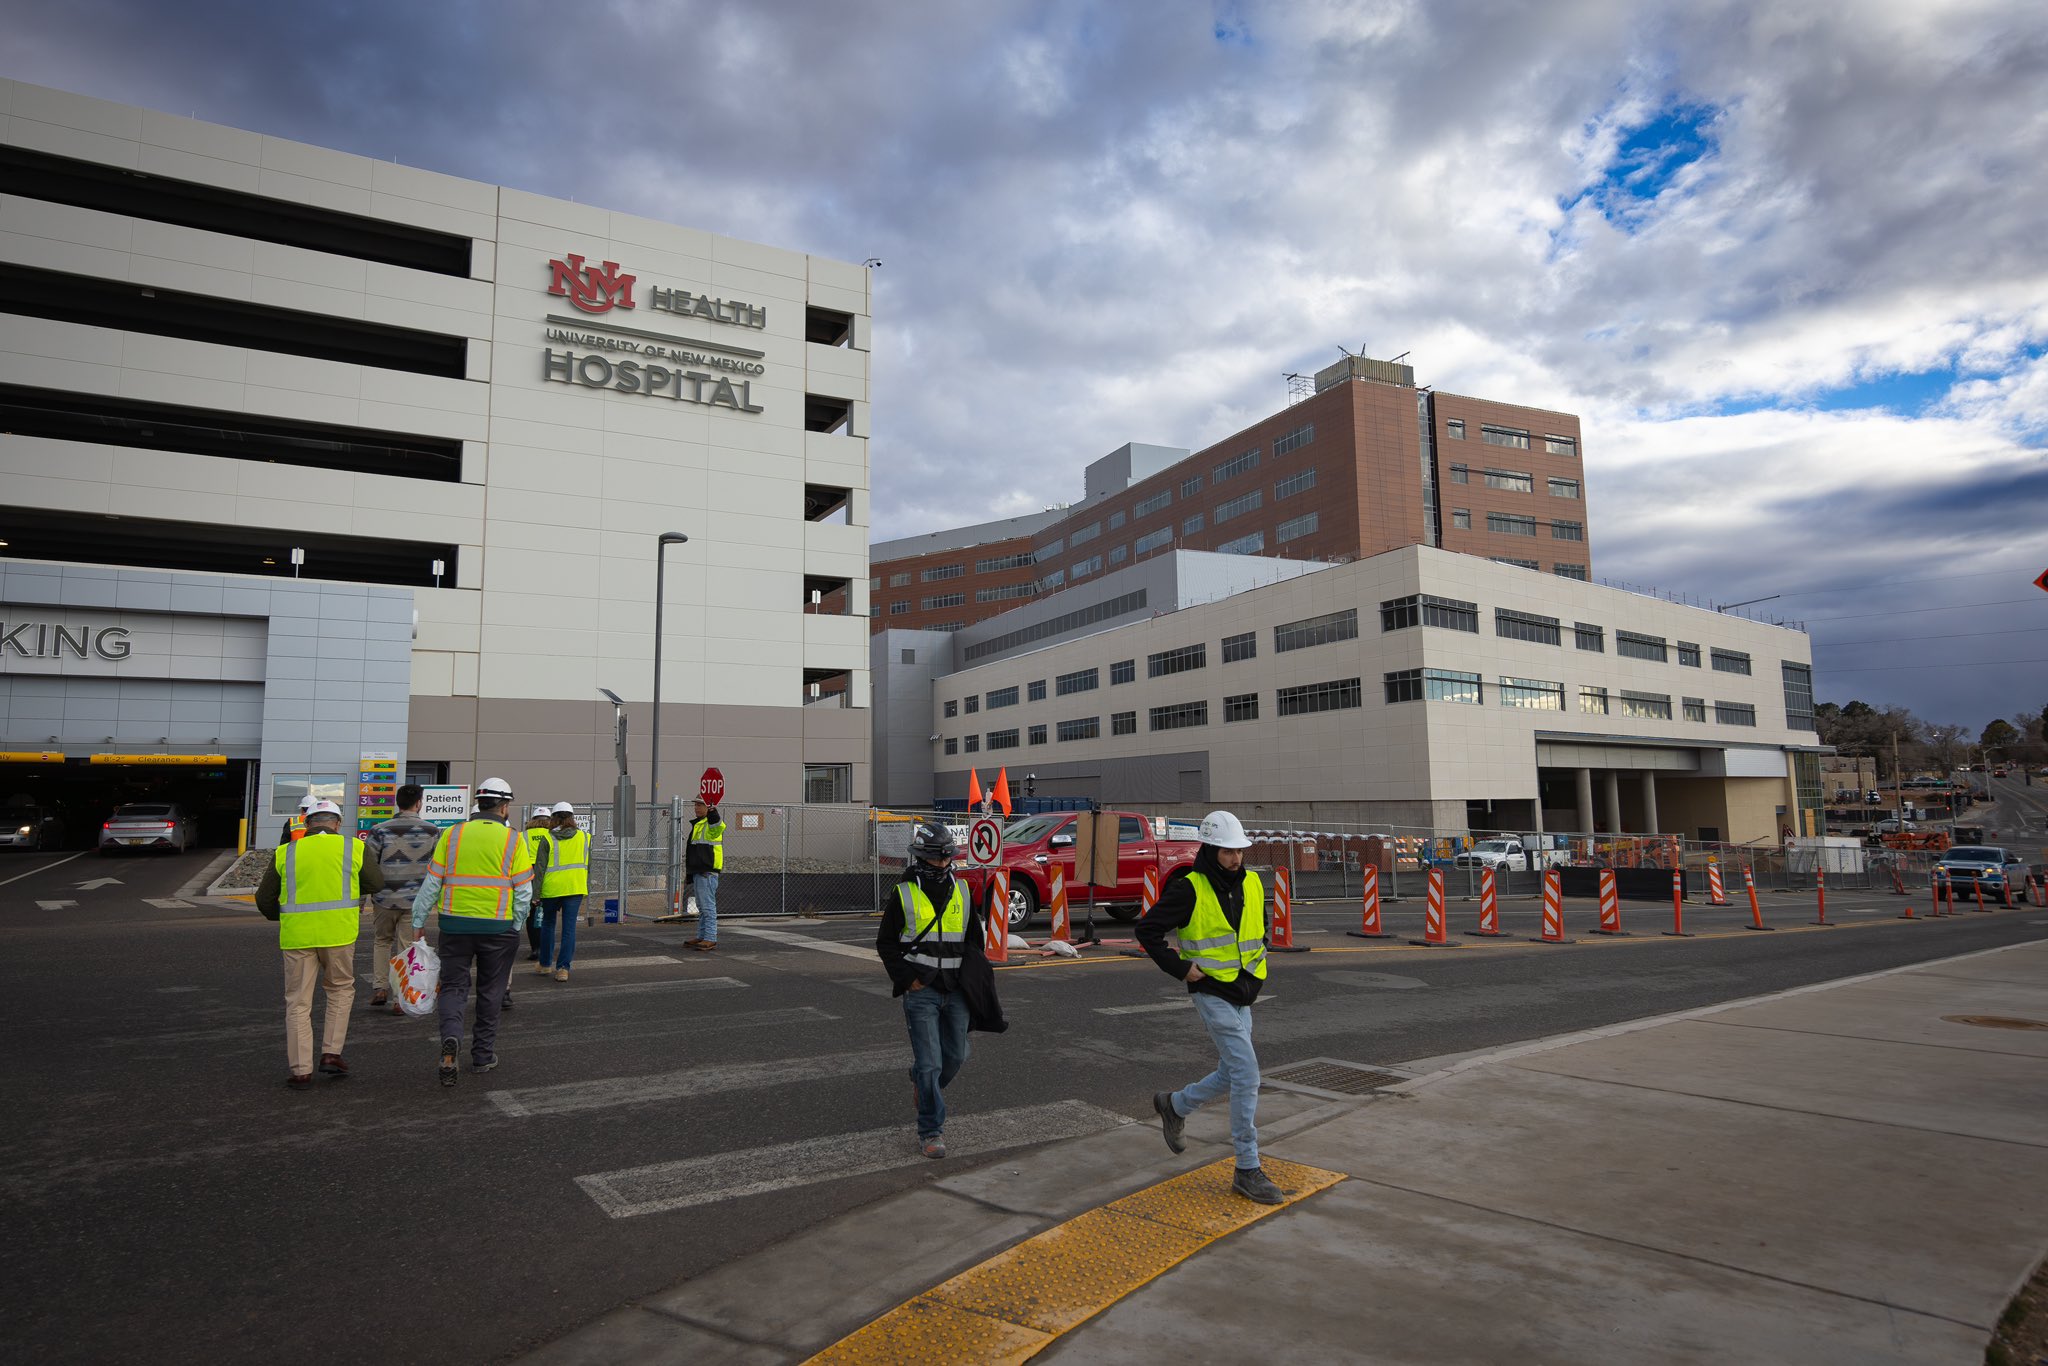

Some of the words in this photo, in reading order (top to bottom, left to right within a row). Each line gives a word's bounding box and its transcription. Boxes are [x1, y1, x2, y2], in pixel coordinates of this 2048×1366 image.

[651, 285, 767, 329] HEALTH
[546, 328, 640, 354] UNIVERSITY
[644, 345, 666, 358] OF
[671, 349, 706, 367] NEW
[710, 356, 765, 377] MEXICO
[544, 347, 764, 413] HOSPITAL
[362, 773, 369, 782] 5
[701, 779, 724, 794] STOP
[360, 796, 368, 805] 3
[426, 794, 462, 803] Patient
[360, 808, 367, 817] 2
[425, 805, 464, 815] Parking
[359, 832, 367, 840] G
